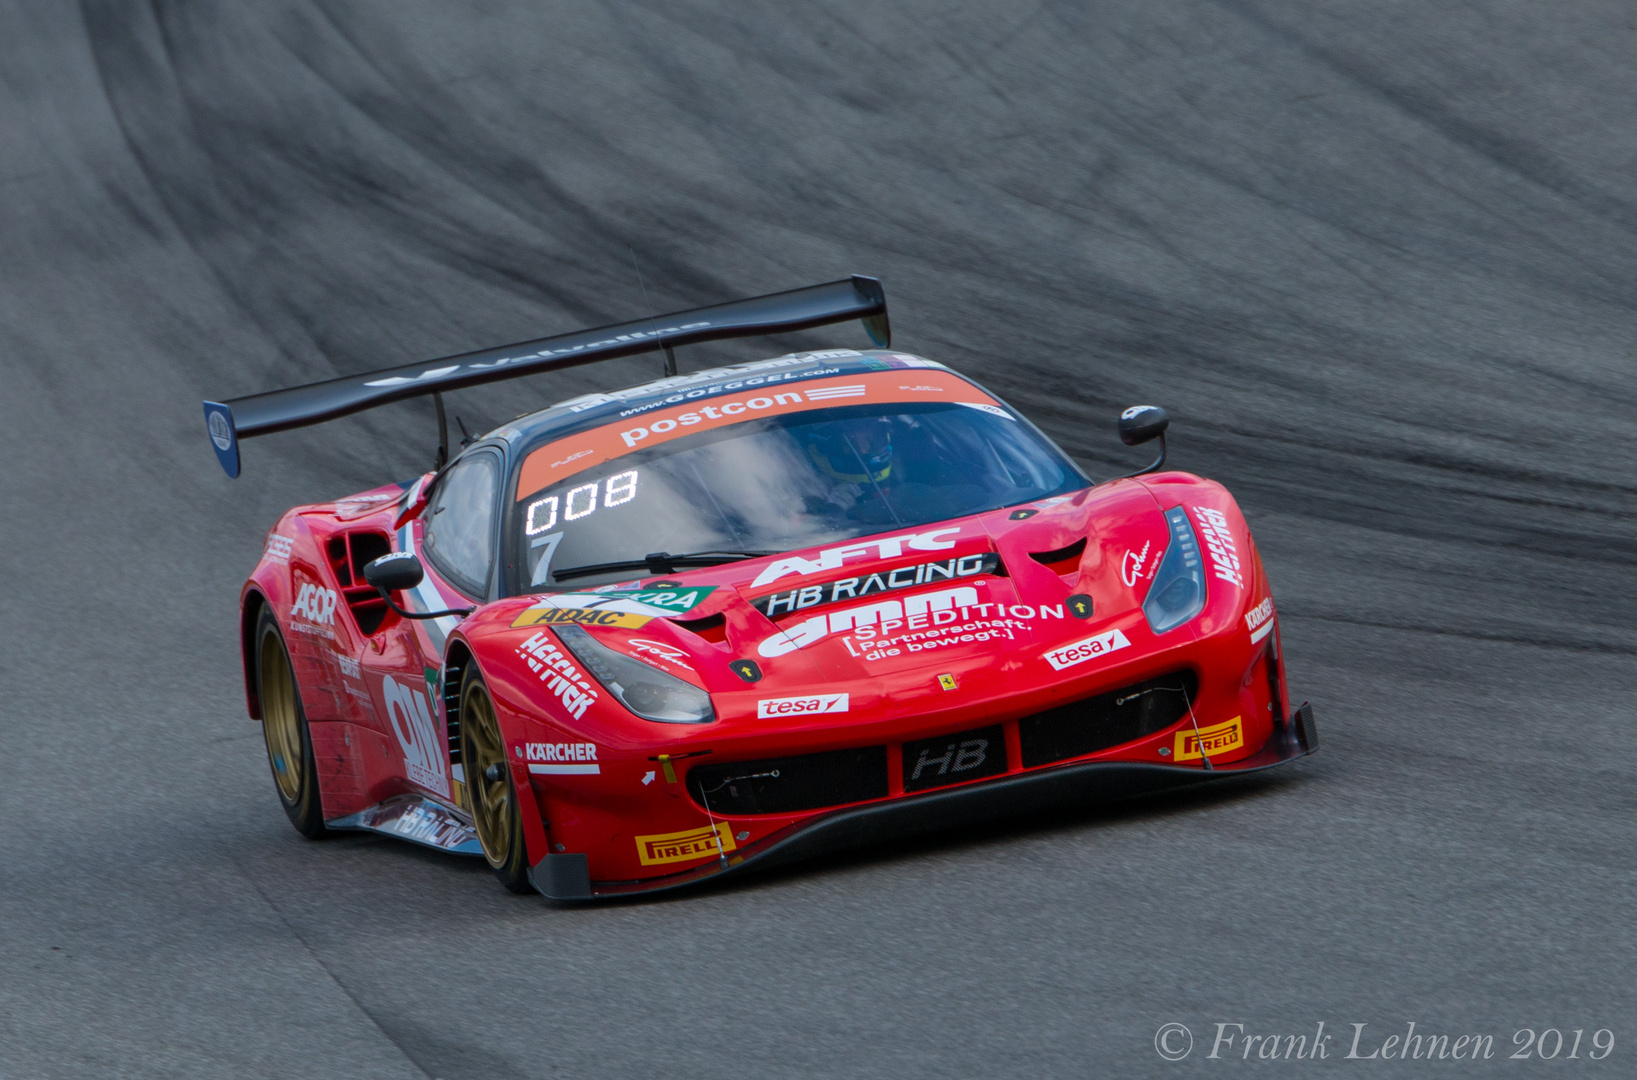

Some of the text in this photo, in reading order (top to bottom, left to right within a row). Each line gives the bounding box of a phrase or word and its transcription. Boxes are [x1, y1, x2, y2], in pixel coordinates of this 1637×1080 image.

[620, 390, 803, 447] postcon
[530, 531, 564, 587] 7
[750, 527, 961, 588] AFTC
[290, 582, 337, 626] AGOR
[766, 553, 984, 617] HB RACING
[534, 608, 625, 625] ADAC
[854, 603, 1065, 641] SPEDITION
[865, 648, 901, 662] die
[1051, 640, 1105, 666] tesa
[762, 697, 821, 715] tesa
[525, 743, 598, 762] KÄRCHER
[1184, 724, 1239, 754] PIRELLI
[912, 739, 989, 781] HB
